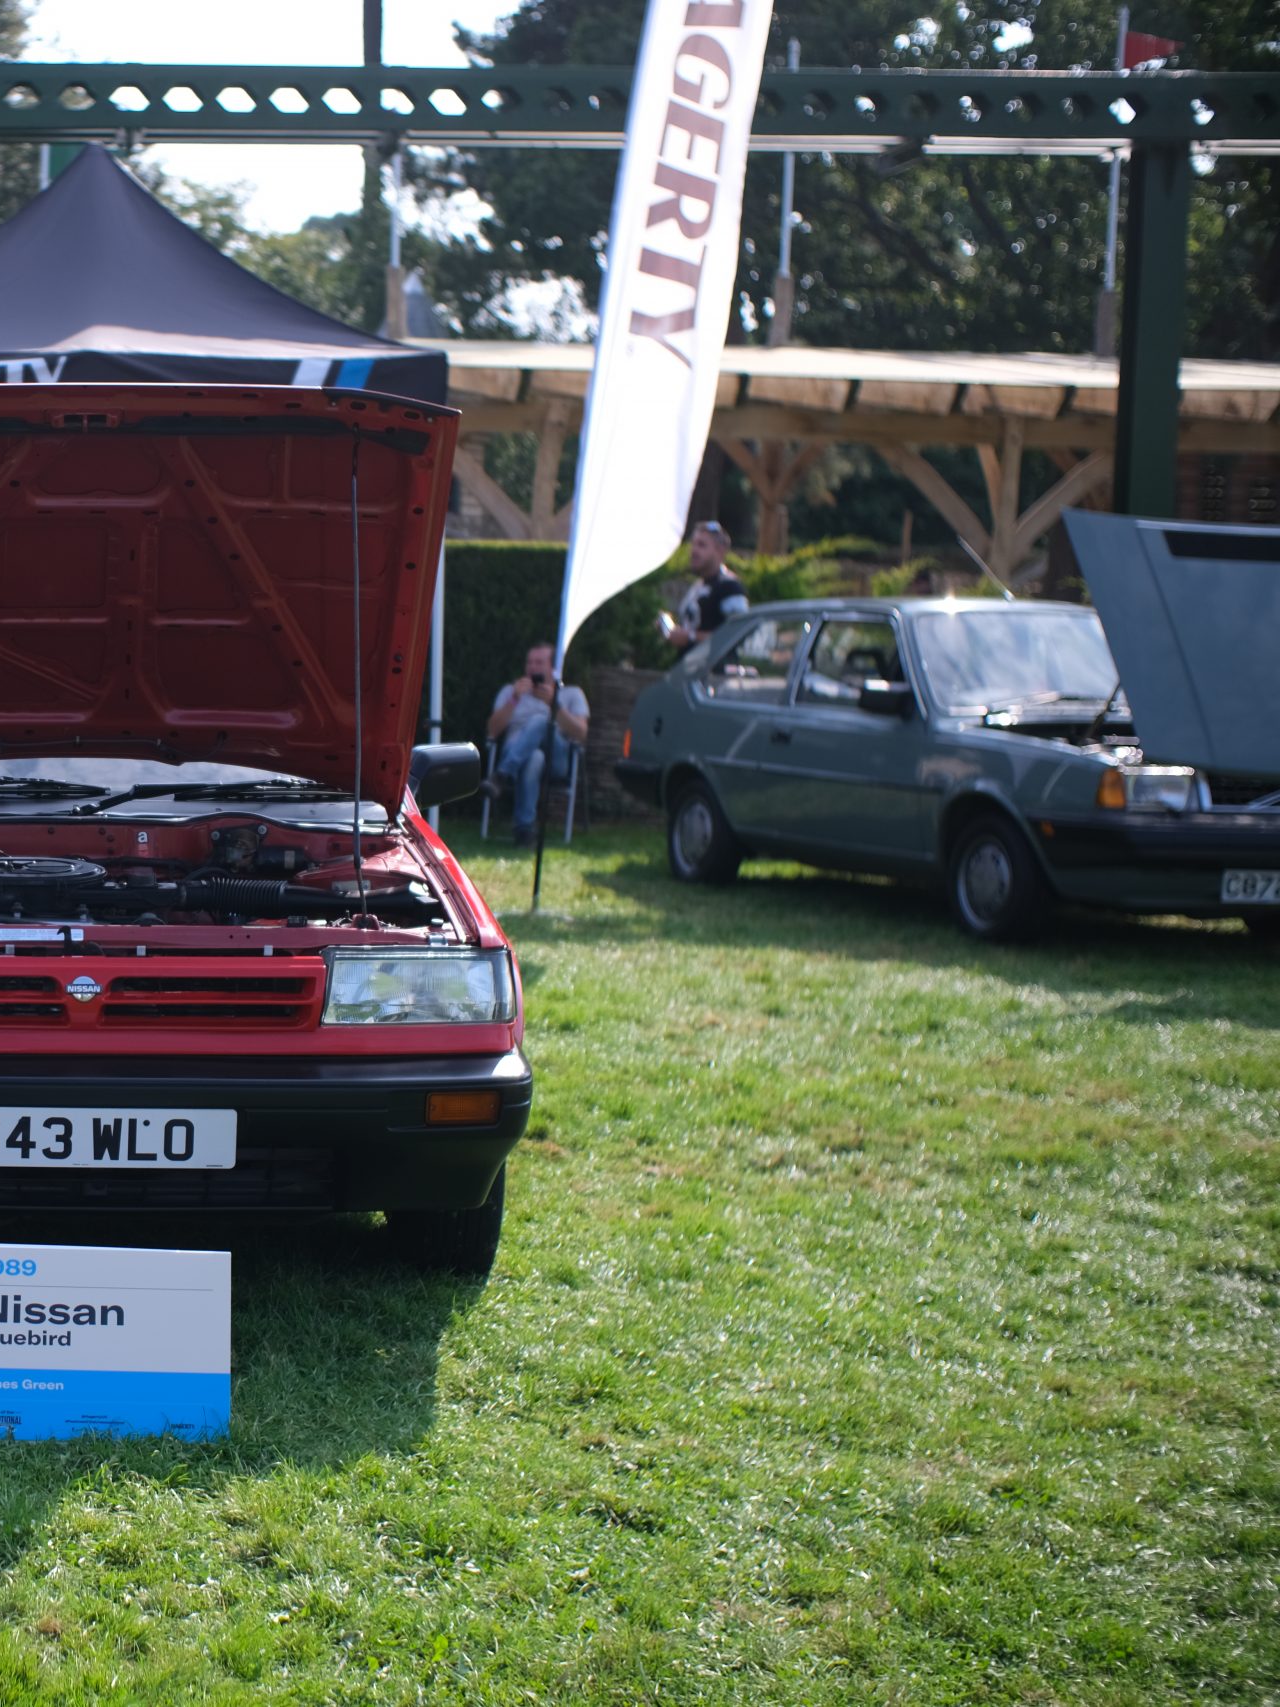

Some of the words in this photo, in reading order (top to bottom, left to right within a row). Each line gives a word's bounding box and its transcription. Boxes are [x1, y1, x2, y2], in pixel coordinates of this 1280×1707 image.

[67, 985, 101, 993] NISSAN
[92, 1117, 195, 1161] WLO
[22, 1378, 64, 1391] Green
